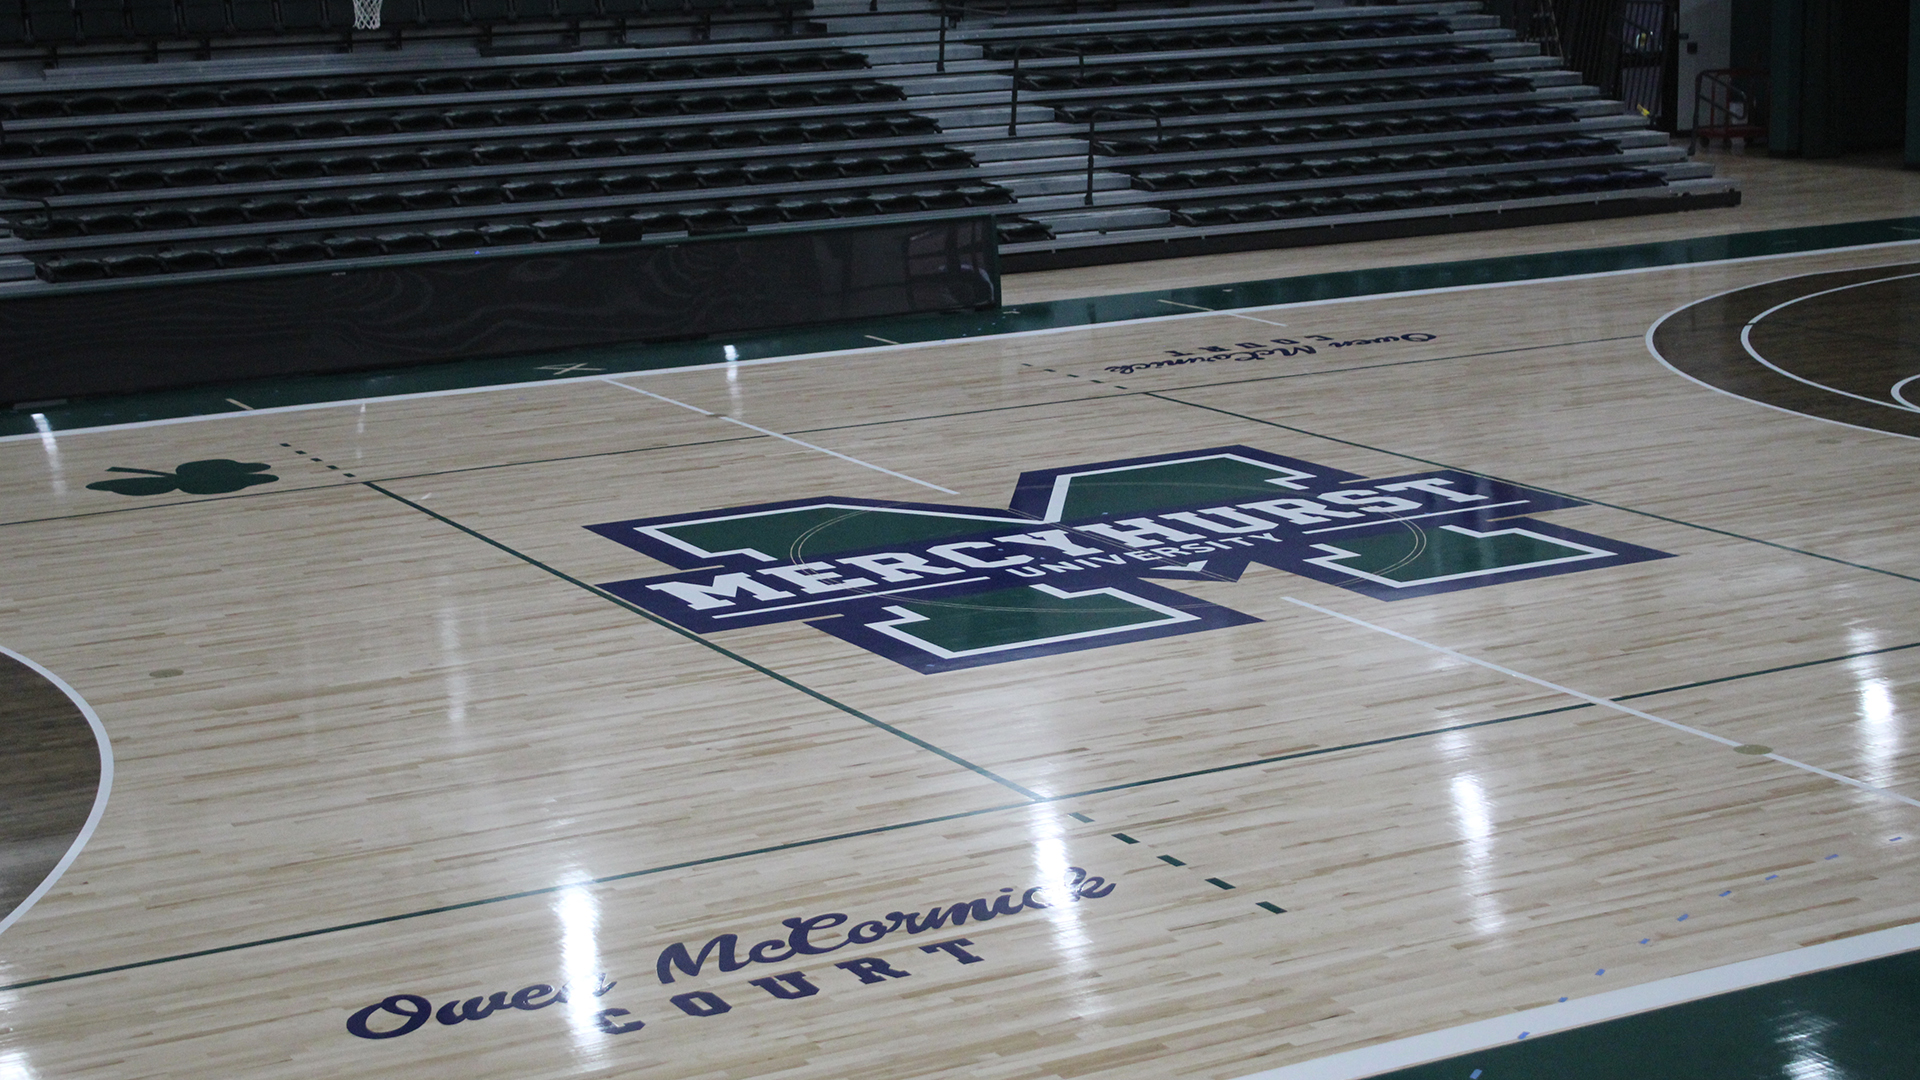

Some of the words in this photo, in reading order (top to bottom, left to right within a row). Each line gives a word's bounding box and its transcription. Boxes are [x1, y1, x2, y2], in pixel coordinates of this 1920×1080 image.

[1165, 334, 1335, 358] COURT
[1328, 332, 1437, 348] Owen
[1103, 345, 1318, 375] McCormick
[644, 477, 1491, 611] MERCYHURST
[1004, 532, 1284, 578] UNIVERSITY
[595, 937, 986, 1035] COURT
